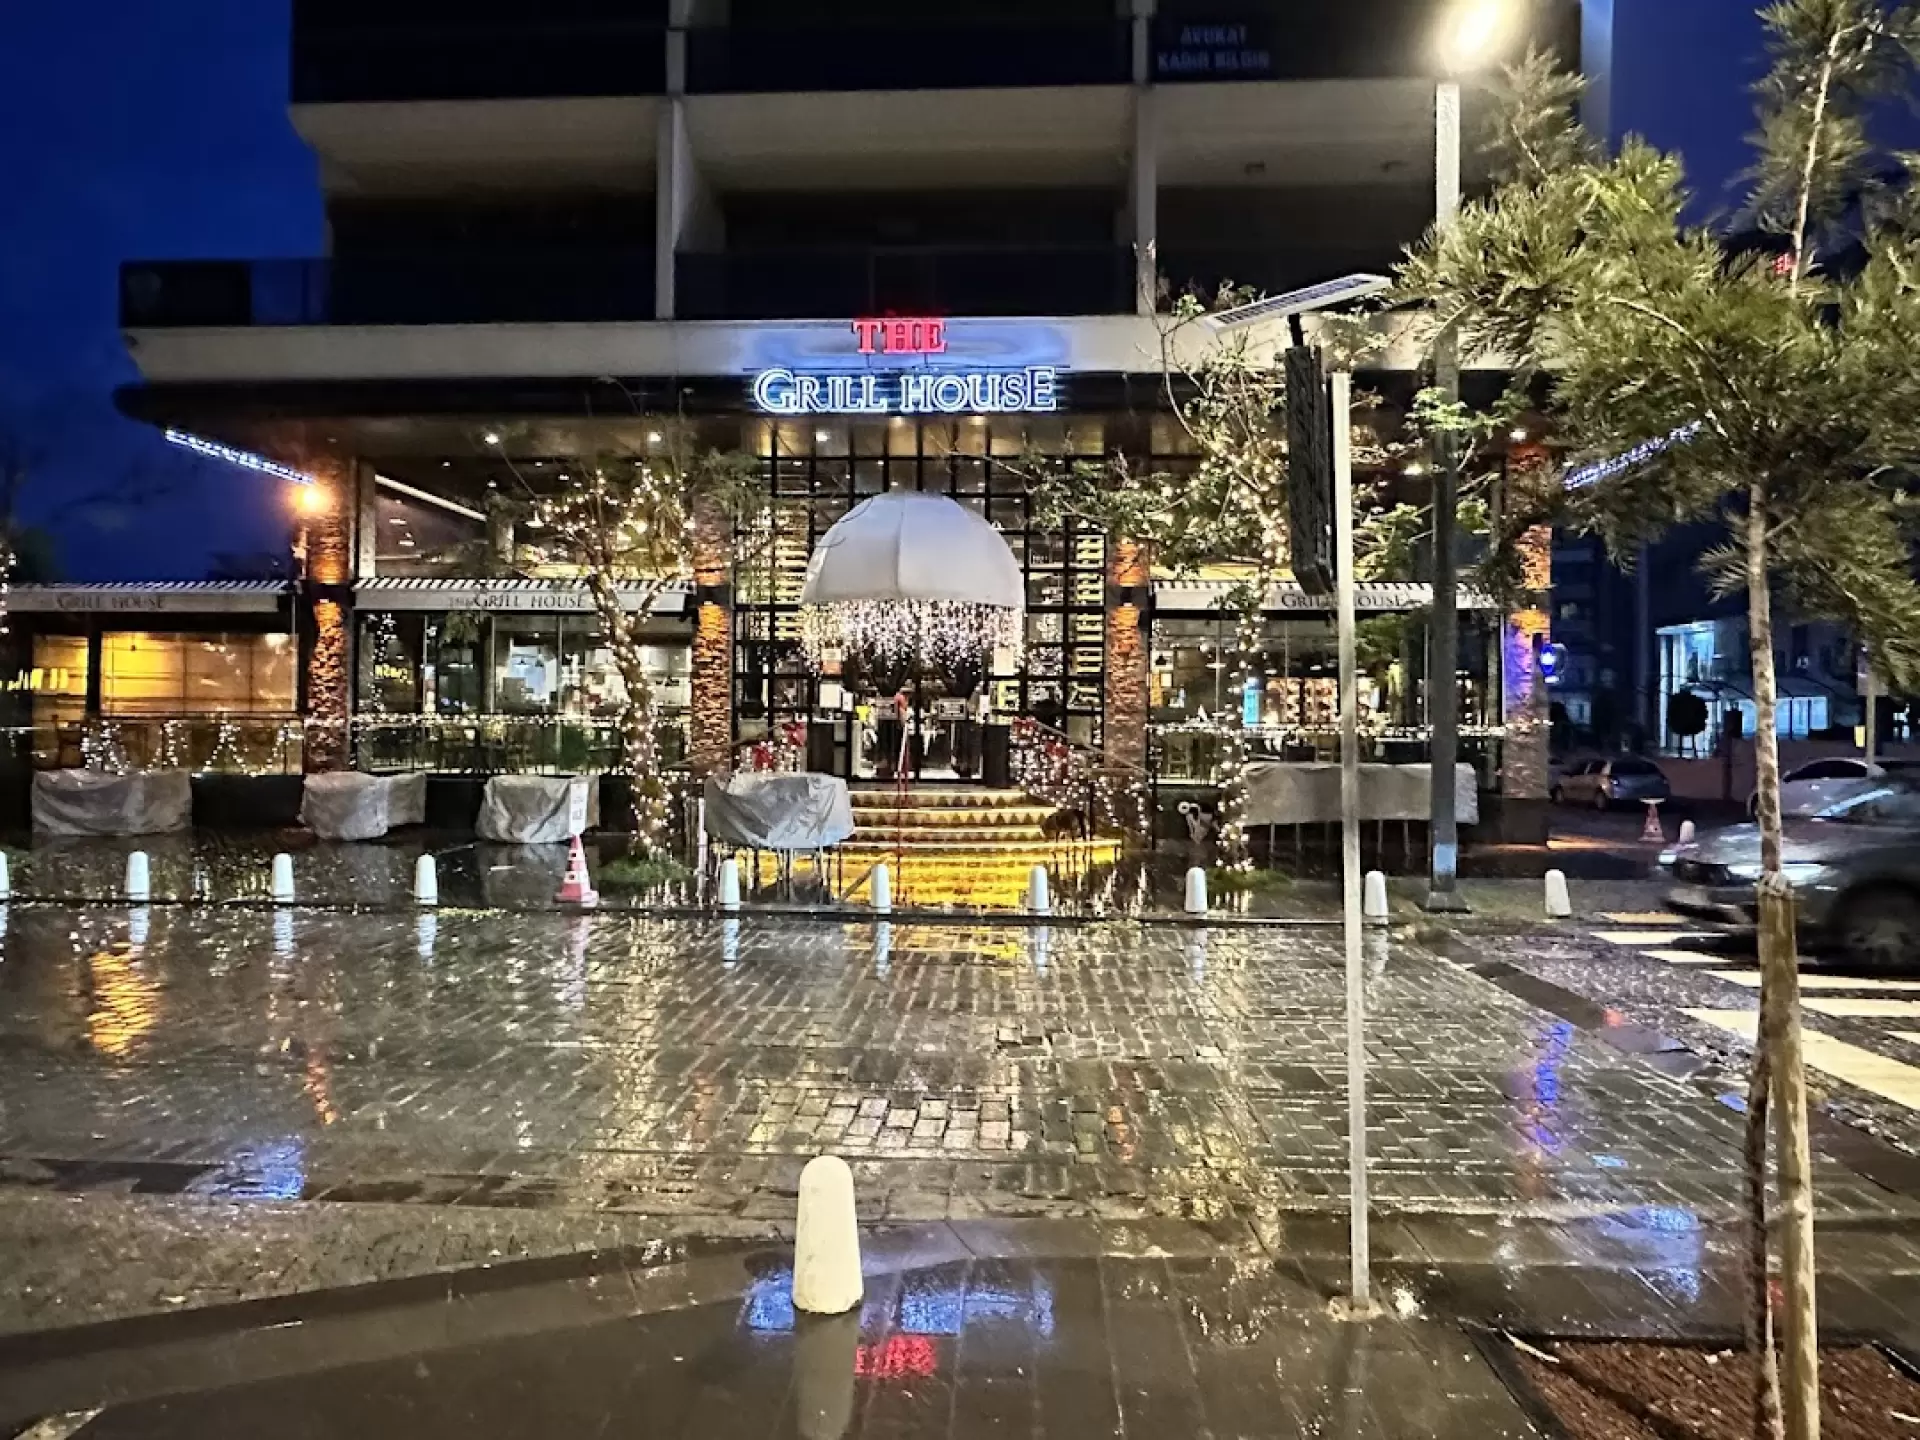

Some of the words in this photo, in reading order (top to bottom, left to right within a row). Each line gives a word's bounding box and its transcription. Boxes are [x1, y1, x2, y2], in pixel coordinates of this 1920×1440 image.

[1180, 24, 1247, 45] AVUKAT
[852, 318, 947, 355] THE
[753, 368, 887, 414] GRILL
[899, 366, 1057, 413] HOUSE
[111, 593, 164, 609] HOUSE
[530, 593, 586, 608] HOUSE
